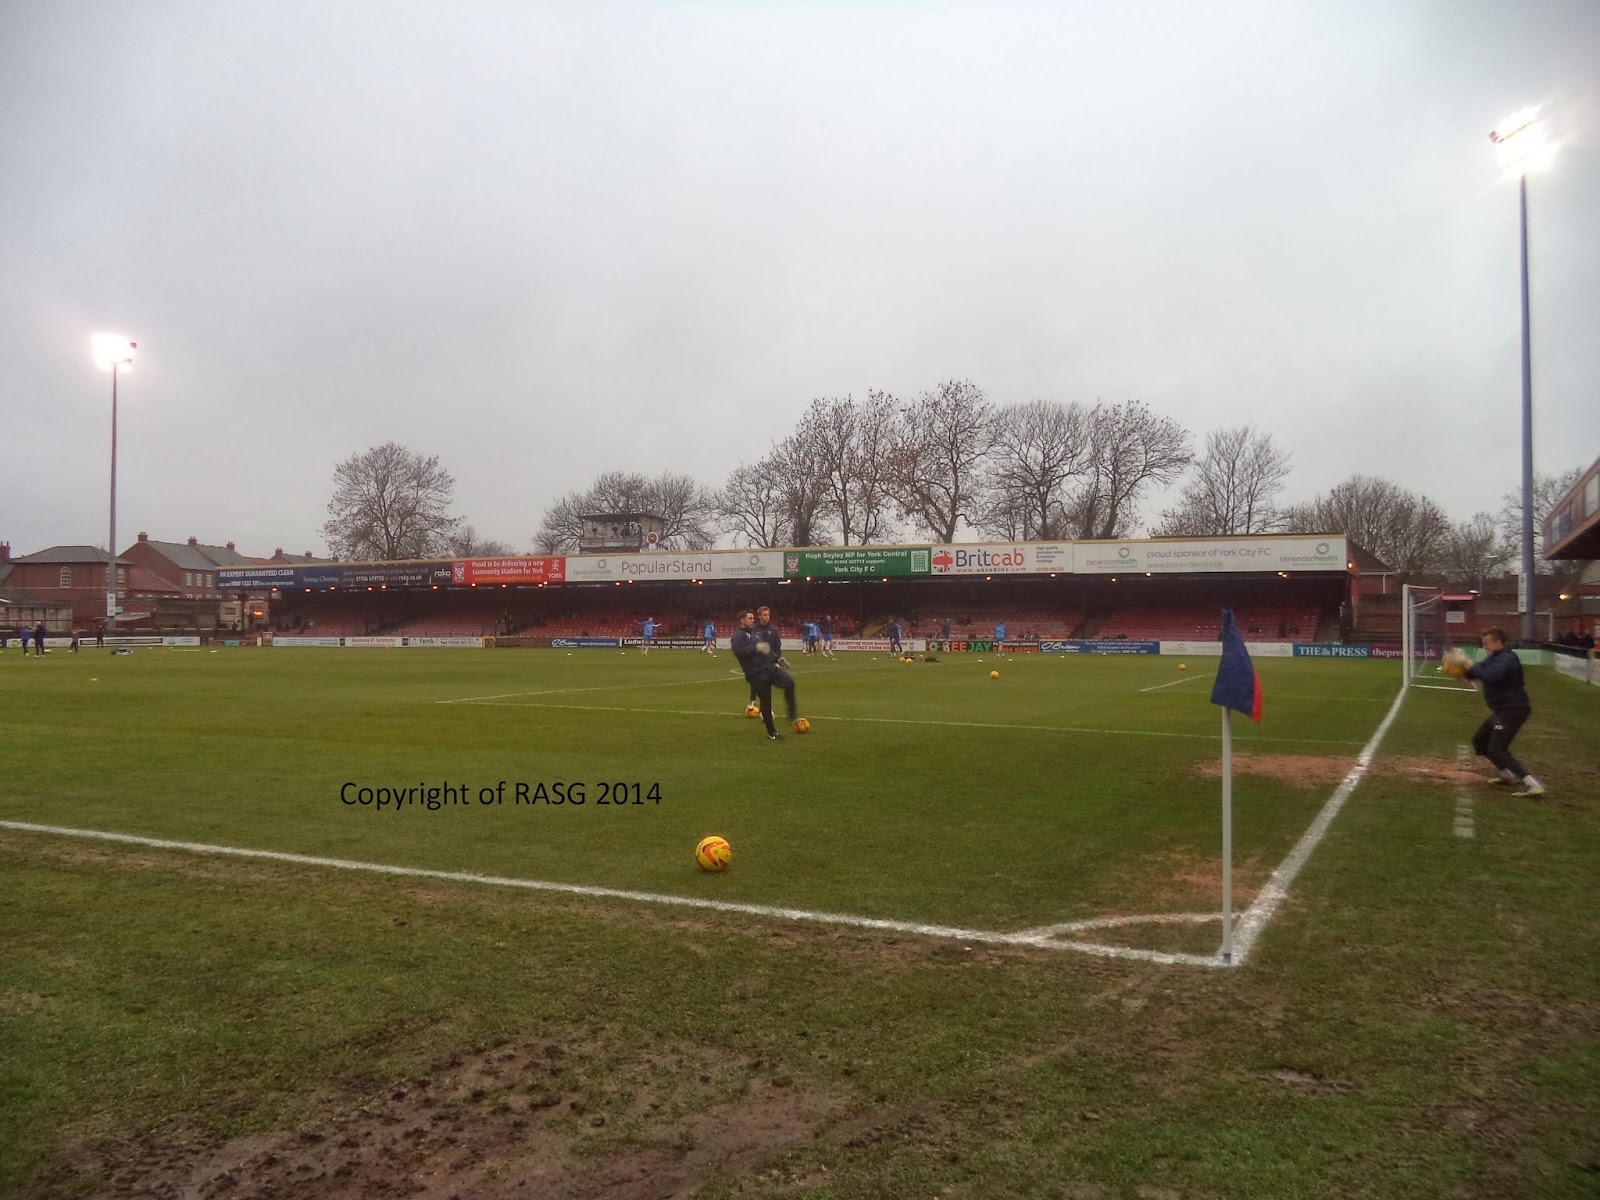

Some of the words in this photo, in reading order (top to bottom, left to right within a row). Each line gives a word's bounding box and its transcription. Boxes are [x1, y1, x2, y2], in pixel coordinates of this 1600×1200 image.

[956, 548, 1024, 567] Britcab
[1174, 550, 1206, 558] sponsor
[1218, 548, 1236, 556] York
[1238, 548, 1256, 557] City
[1258, 548, 1272, 556] FC
[501, 560, 526, 568] delivering
[1299, 647, 1322, 656] THE
[1331, 648, 1367, 657] PRESS
